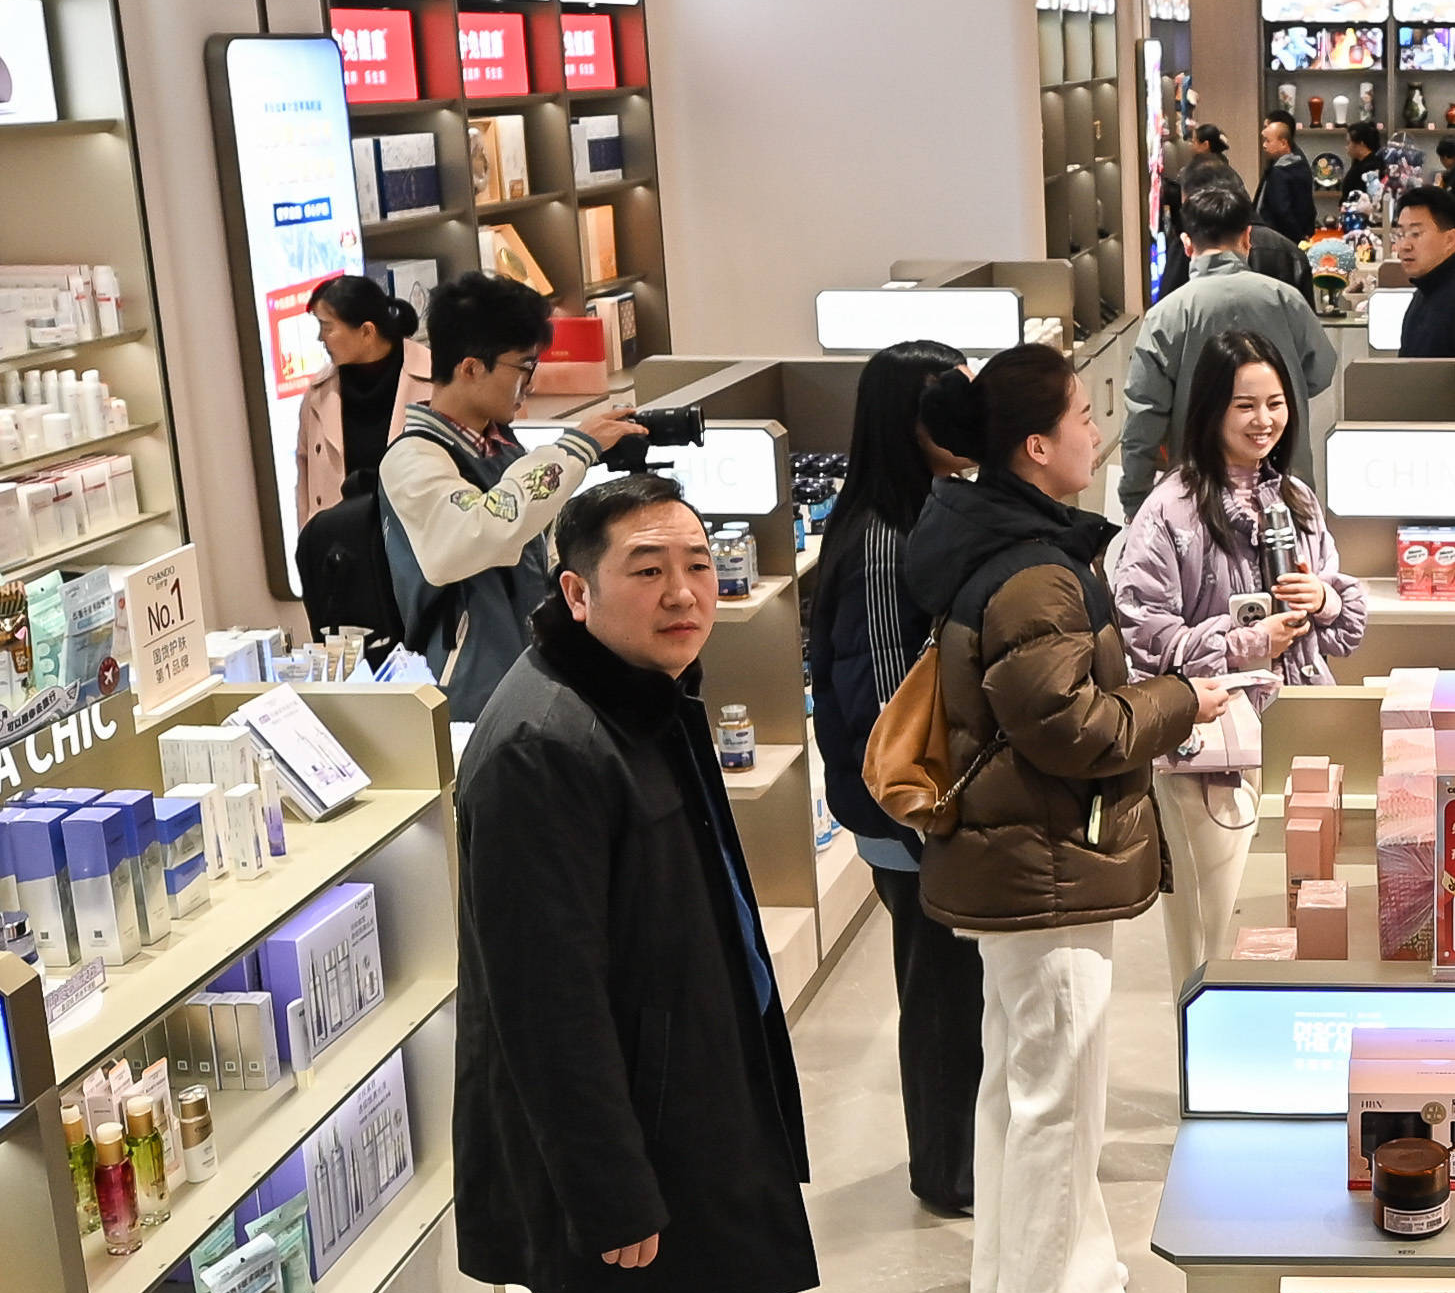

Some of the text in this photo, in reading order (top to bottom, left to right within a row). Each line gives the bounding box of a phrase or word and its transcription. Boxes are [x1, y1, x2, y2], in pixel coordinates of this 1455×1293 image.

[147, 565, 175, 586] CHANDO
[147, 577, 185, 636] No.1
[25, 702, 117, 775] CHIC
